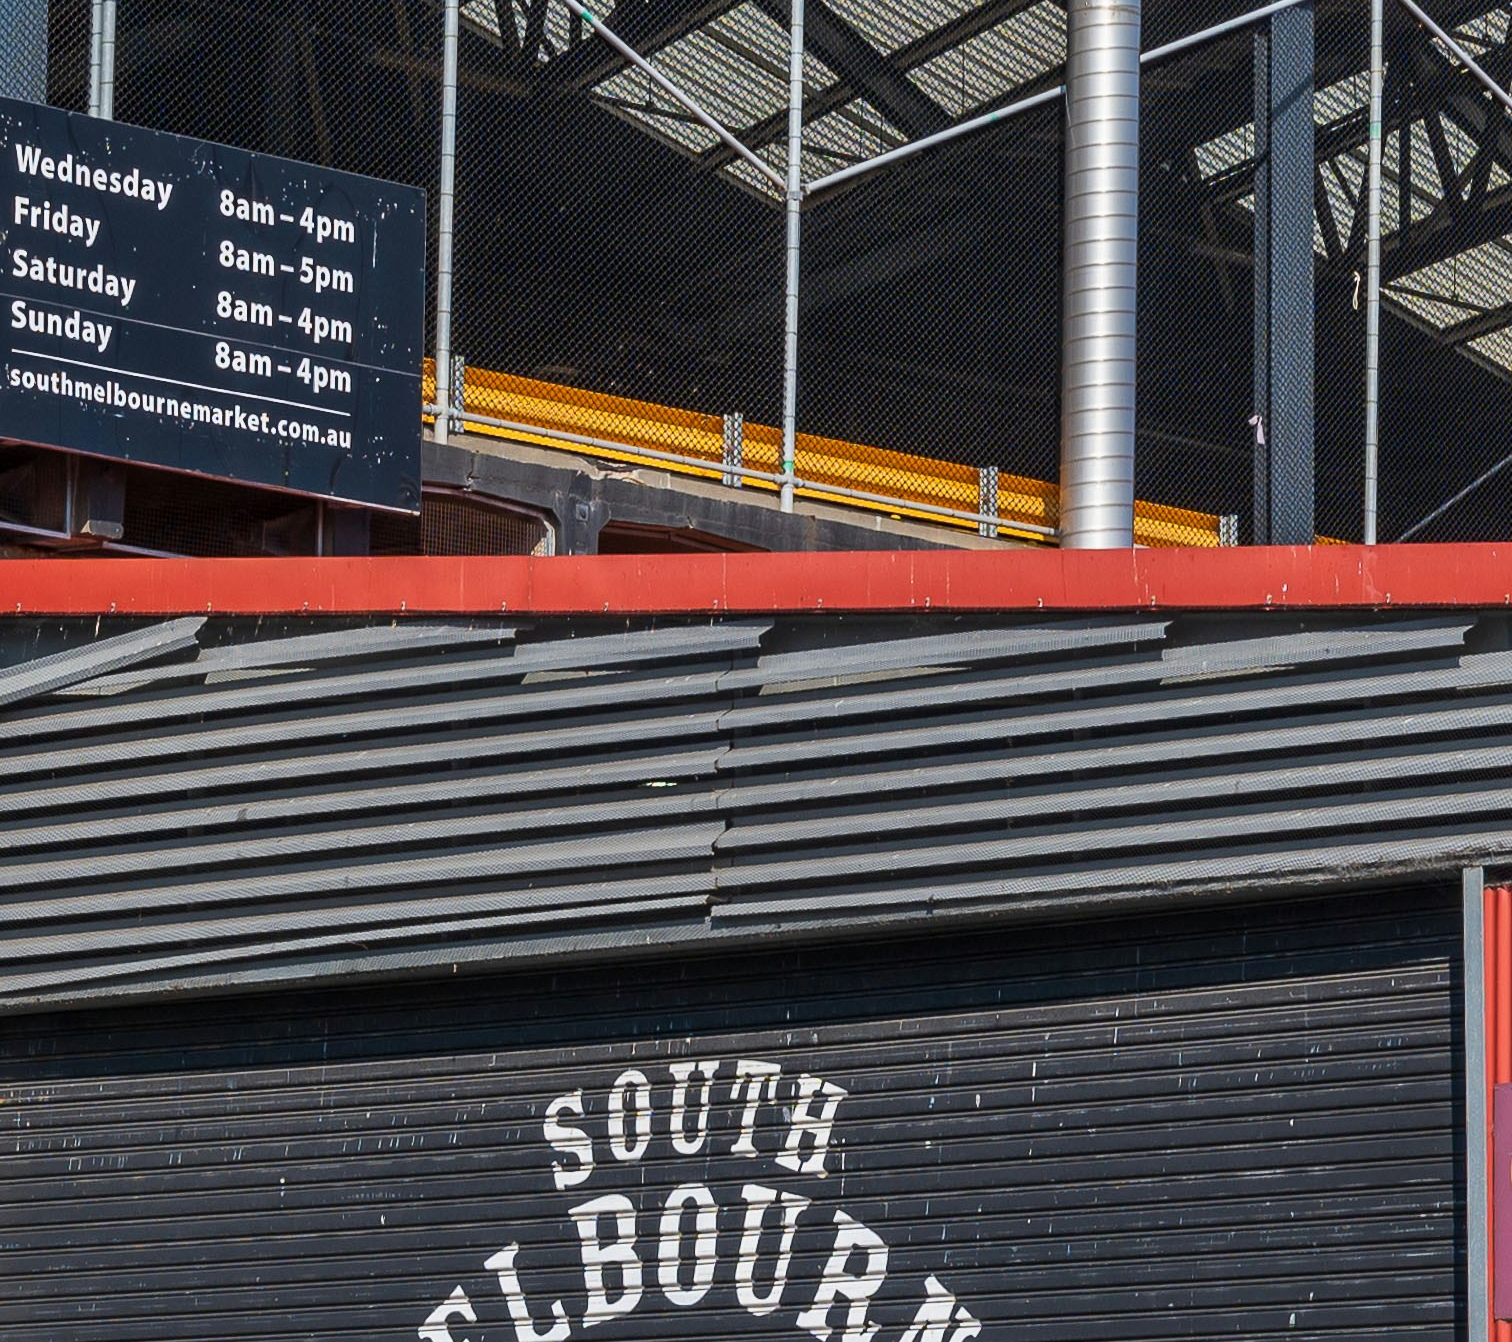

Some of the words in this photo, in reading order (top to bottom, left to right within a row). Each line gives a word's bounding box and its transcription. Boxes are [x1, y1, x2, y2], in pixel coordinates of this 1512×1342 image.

[15, 144, 173, 210] Wednesday
[14, 196, 100, 247] Friday
[12, 249, 136, 306] Saturday
[11, 300, 113, 352] Sunday
[10, 368, 351, 449] southmelbournemarket.com.au
[542, 1059, 848, 1190] SOUTH
